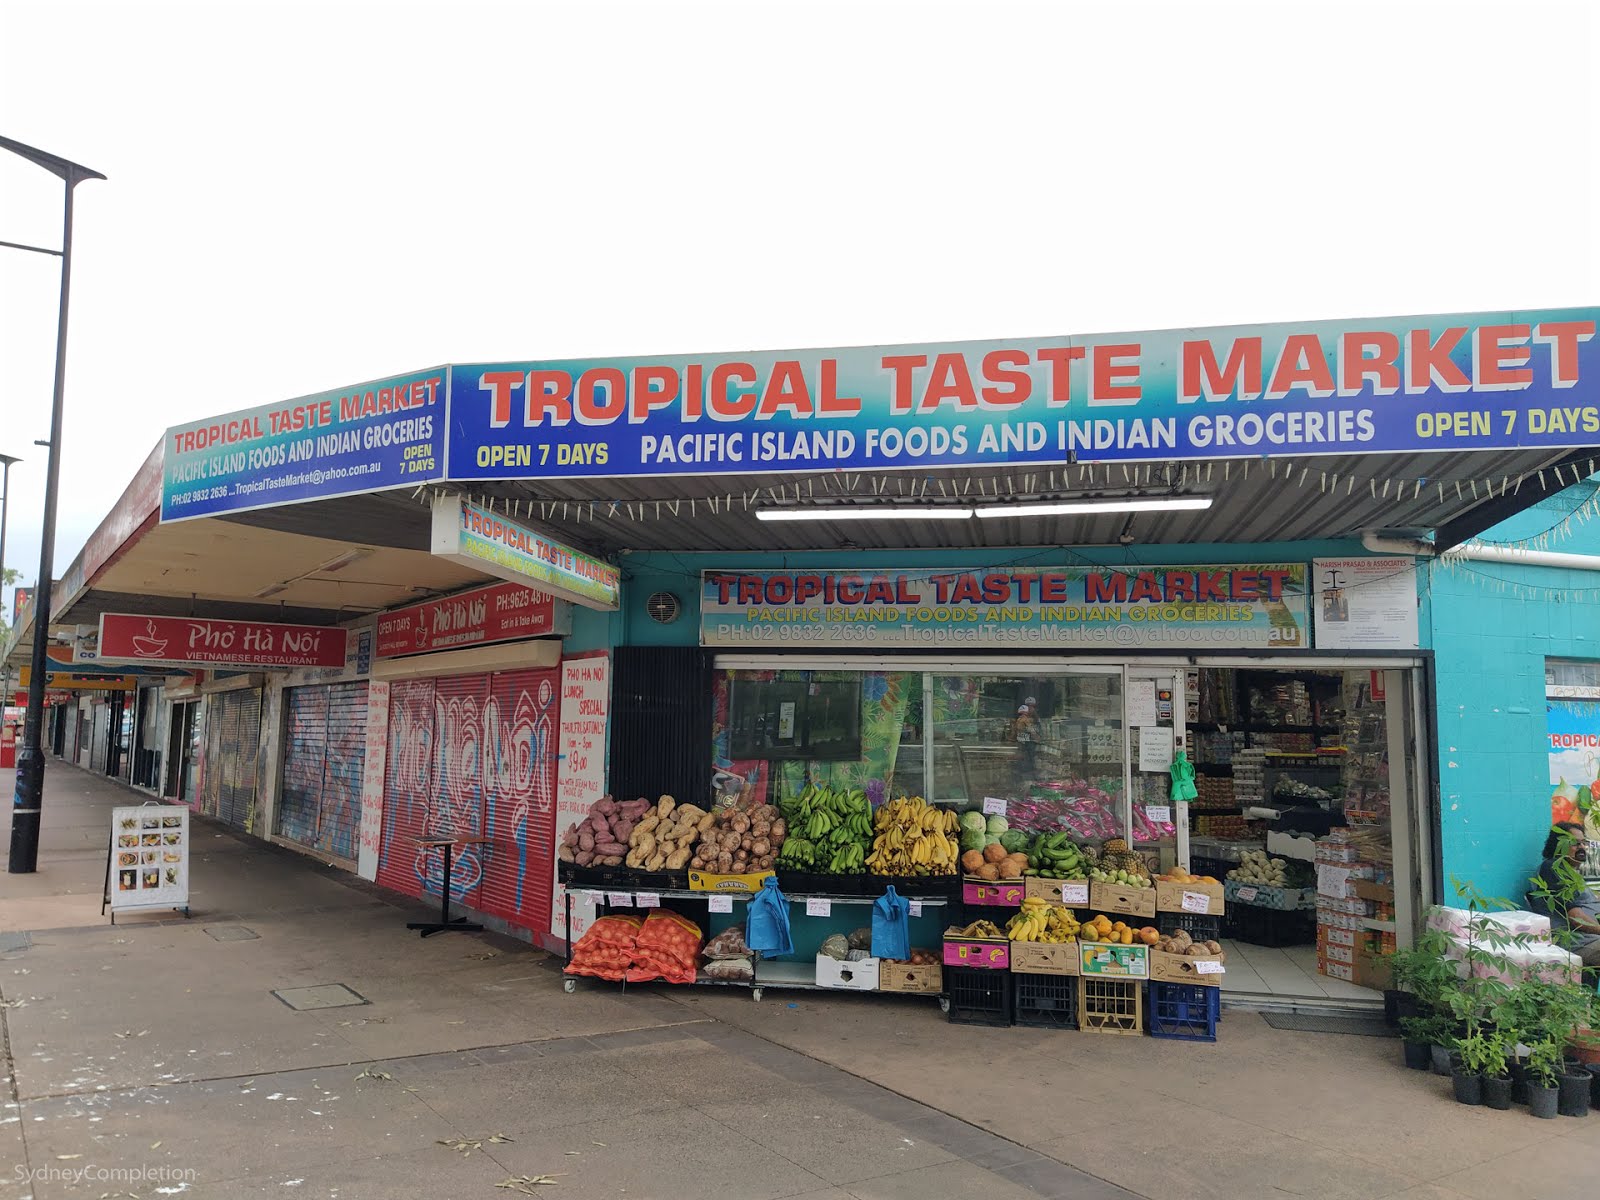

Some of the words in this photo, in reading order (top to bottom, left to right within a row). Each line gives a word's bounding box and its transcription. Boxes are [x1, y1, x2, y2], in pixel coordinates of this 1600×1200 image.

[478, 359, 862, 429] TROPICAL
[881, 343, 1142, 416] TASTE
[1176, 320, 1596, 405] MARKET
[174, 416, 264, 454] TROPICAL
[268, 400, 332, 436] TASTE
[338, 377, 441, 423] MARKET
[1415, 411, 1492, 439] OPEN
[1500, 410, 1515, 435] 7
[1528, 406, 1599, 435] DAYS
[640, 432, 743, 464] PACIFIC
[751, 428, 856, 461] ISLAND
[865, 424, 966, 459] FOODS
[976, 421, 1047, 454] AND
[1057, 417, 1178, 451] INDIAN
[1187, 409, 1376, 447] GROCERIES
[172, 458, 207, 484] PACIFIC
[209, 451, 246, 478] ISLAND
[248, 443, 286, 471] FOODS
[288, 438, 314, 463] AND
[316, 429, 360, 458] INDIAN
[363, 415, 433, 450] GROCERIES
[403, 443, 433, 460] OPEN
[476, 444, 532, 468] OPEN
[538, 443, 552, 466] 7
[556, 442, 609, 466] DAYS
[399, 462, 406, 475] 7
[408, 458, 435, 474] DAYS
[171, 492, 191, 506] PH:02
[192, 488, 209, 502] 9832
[210, 485, 228, 499] 2636
[462, 505, 534, 555] TROPICAL
[536, 540, 572, 571] TASTE
[575, 556, 619, 588] MARKET
[466, 537, 496, 561] PACIFIC
[524, 559, 547, 579] FOODS
[1343, 560, 1366, 568] PRASAD
[1373, 559, 1407, 567] ASSOCIATES
[712, 573, 921, 606] TROPICAL
[929, 571, 1067, 605] TASTE
[1085, 568, 1291, 604] MARKET
[496, 590, 529, 612] PH:9625
[501, 619, 509, 629] Eat
[519, 616, 531, 626] Take
[531, 614, 545, 625] Away
[747, 607, 820, 623] PACIFIC
[825, 607, 900, 623] ISLAND
[905, 607, 978, 623] FOODS
[985, 606, 1034, 622] AND
[1040, 606, 1122, 622] INDIAN
[1128, 605, 1254, 622] GROCERIES
[378, 619, 392, 635] OPEN
[392, 619, 397, 632] 7
[396, 616, 411, 631] DAYS
[716, 624, 773, 641] PH:02
[778, 624, 825, 641] 9832
[830, 624, 877, 641] 2636
[243, 626, 275, 651] Hà
[186, 651, 252, 662] VIETNAMESE
[253, 654, 319, 665] RESTAURANT
[567, 667, 580, 681] PHO
[582, 667, 592, 681] HA
[563, 685, 583, 699] LUNCH
[579, 699, 605, 716] SPECIAL
